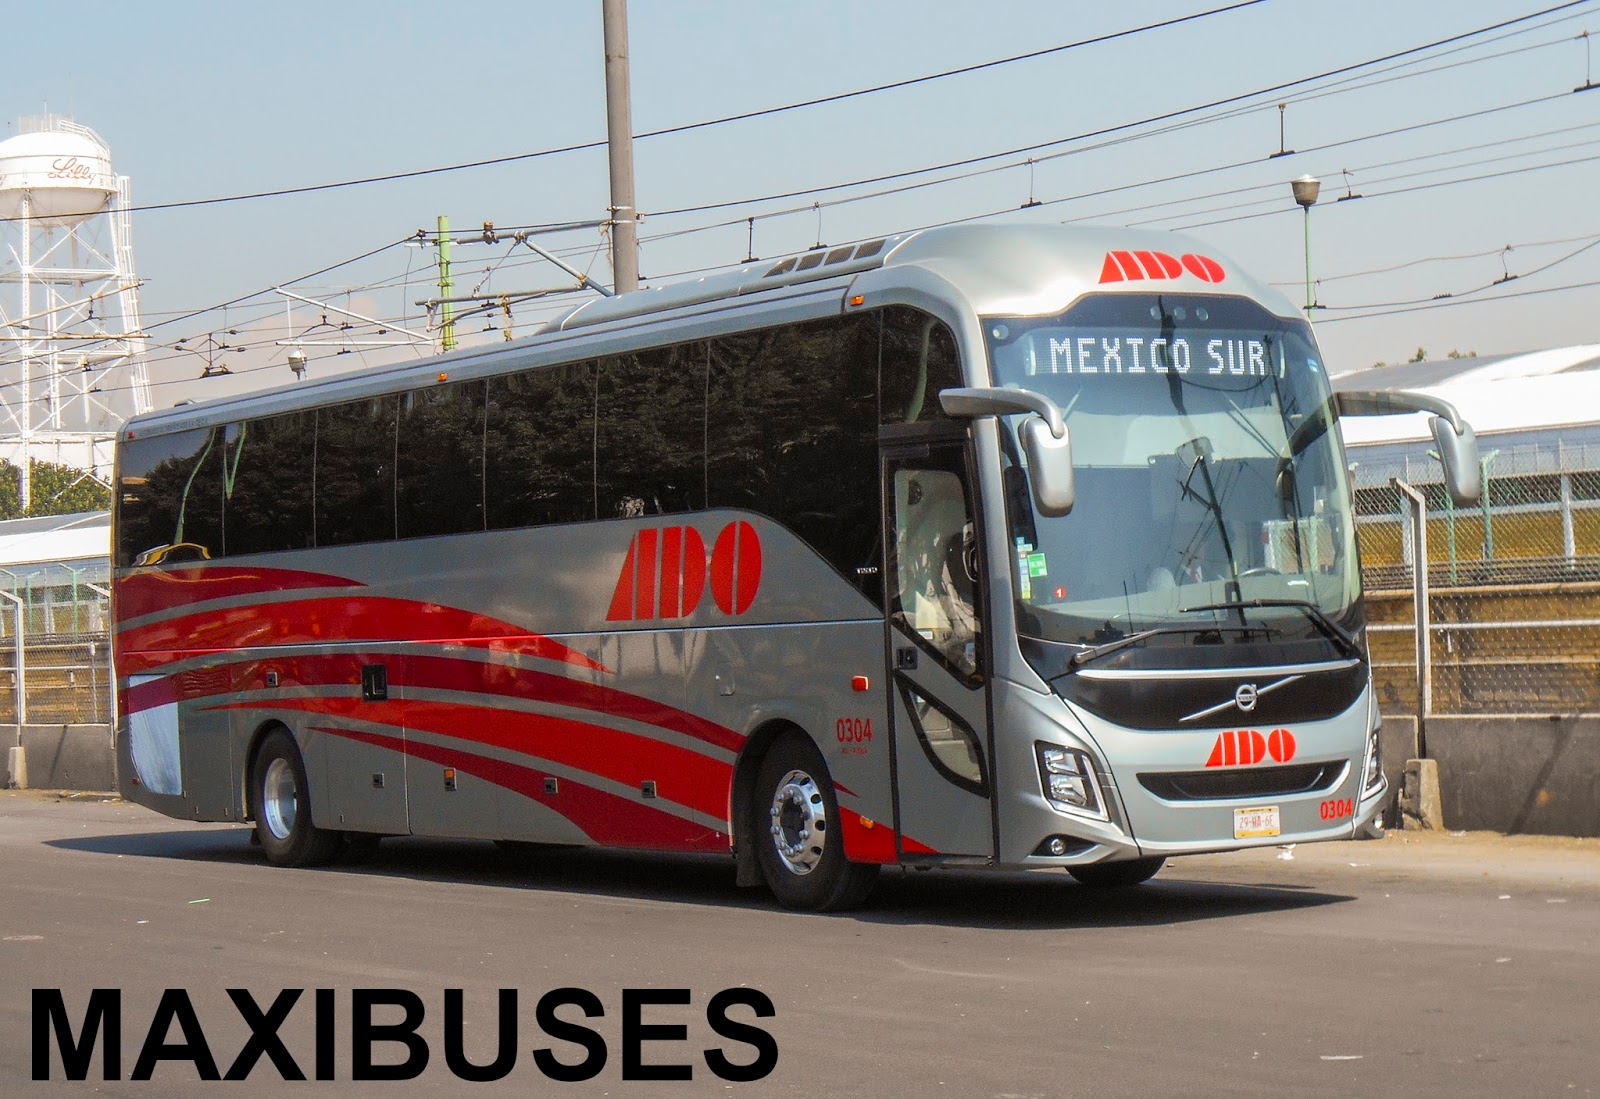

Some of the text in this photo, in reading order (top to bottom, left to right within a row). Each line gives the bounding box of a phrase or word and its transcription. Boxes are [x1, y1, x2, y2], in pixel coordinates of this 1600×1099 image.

[47, 157, 96, 185] Lilly
[1098, 250, 1226, 285] ADO
[1049, 336, 1267, 376] MEXICO SUR
[606, 520, 763, 622] ADO
[836, 718, 873, 743] 0304
[1204, 728, 1297, 768] ADO
[1320, 798, 1354, 821] 0304
